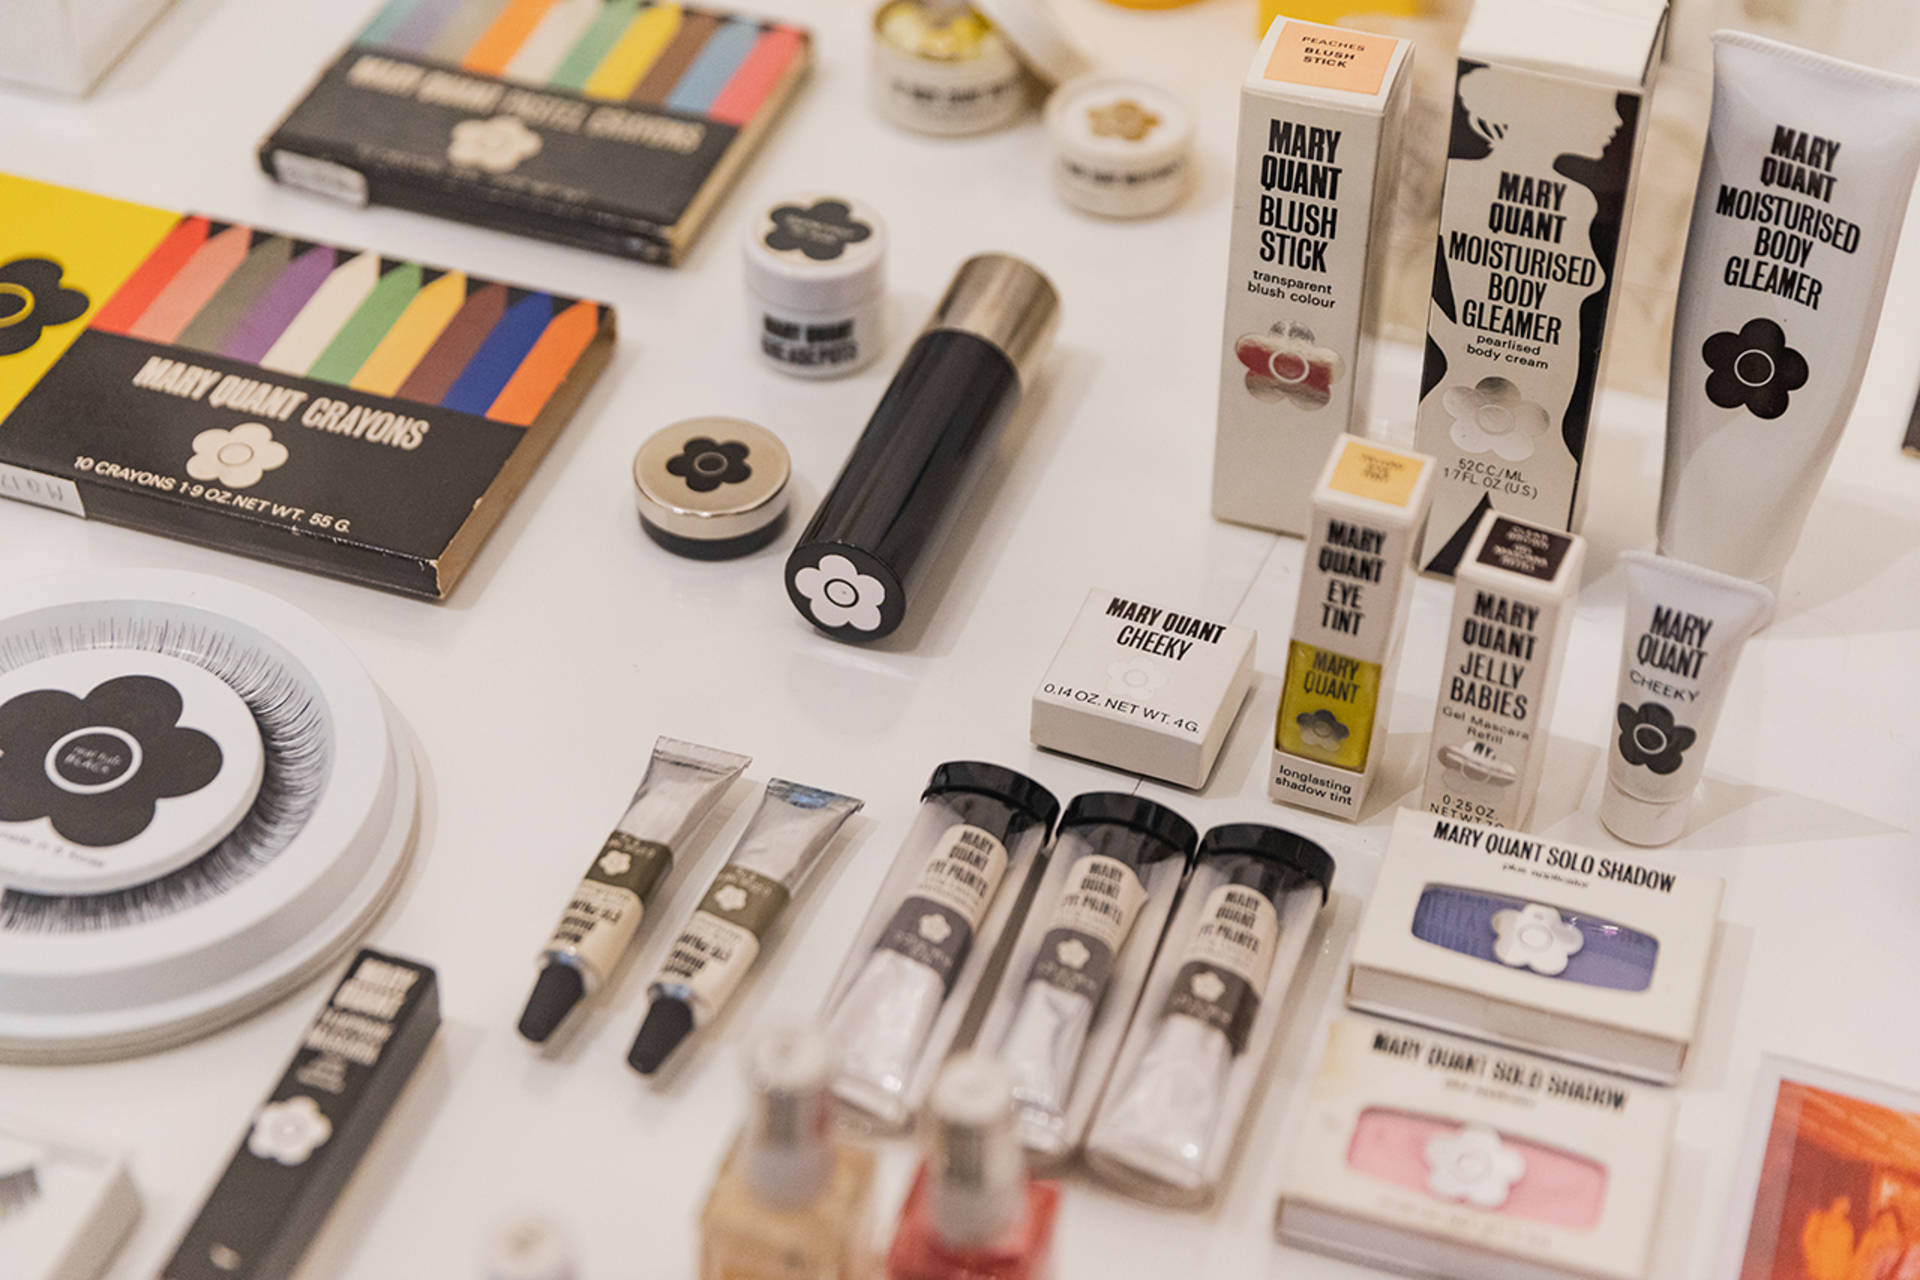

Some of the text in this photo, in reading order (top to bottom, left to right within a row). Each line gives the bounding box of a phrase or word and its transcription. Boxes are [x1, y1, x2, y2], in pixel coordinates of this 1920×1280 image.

[1302, 36, 1365, 51] PEACHES
[1303, 56, 1347, 68] STICK
[1304, 47, 1355, 60] BLUSH
[1268, 118, 1342, 164] MARY
[1771, 125, 1841, 172] MARY
[1260, 154, 1343, 201] QUANT
[1498, 171, 1567, 211] MARY
[1760, 156, 1838, 203] QUANT
[1259, 194, 1338, 240] BLUSH
[1489, 202, 1567, 244] QUANT
[1716, 184, 1861, 254] MOISTURISED
[1259, 230, 1328, 273] STICK
[1449, 230, 1596, 287] MOISTURISED
[1754, 226, 1814, 268] BODY
[1248, 281, 1335, 309] blush colour
[1253, 270, 1332, 294] transparent
[1488, 272, 1547, 309] BODY
[1724, 255, 1823, 311] GLEAMER
[1462, 299, 1562, 345] GLEAMER
[1467, 344, 1548, 370] body cream
[1477, 335, 1541, 356] pearlised
[132, 356, 430, 450] MARY QUANT CRAYONS
[74, 455, 95, 471] 10
[95, 460, 177, 491] CRAYONS
[232, 494, 272, 513] NET
[272, 503, 306, 522] WT.
[308, 512, 333, 528] 55
[1326, 519, 1386, 555] MARY
[1318, 546, 1385, 584] QUANT
[1327, 579, 1364, 609] EYE
[1473, 590, 1540, 631] MARY
[1105, 597, 1226, 644] MARY QUANT
[1321, 602, 1366, 636] TINT
[1650, 604, 1713, 648] MARY
[1116, 625, 1193, 661] CHEEKY
[1462, 618, 1538, 661] QUANT
[1637, 634, 1708, 679] QUANT
[1313, 652, 1360, 681] MARY
[1460, 651, 1525, 690] JELLY
[1630, 670, 1700, 701] CHEEKY
[1043, 683, 1072, 697] 0.14
[1074, 690, 1101, 706] OZ.
[1105, 698, 1140, 715] NET
[1143, 708, 1170, 725] WT.
[1303, 671, 1360, 703] QUANT
[1449, 676, 1528, 720] BABIES
[1442, 706, 1530, 740] Gel Mascara
[1467, 727, 1503, 745] Refill
[1275, 775, 1352, 806] shadow tint
[1279, 764, 1352, 795] longlasting
[1433, 821, 1676, 893] MARY QUANT SOLO SHADOW
